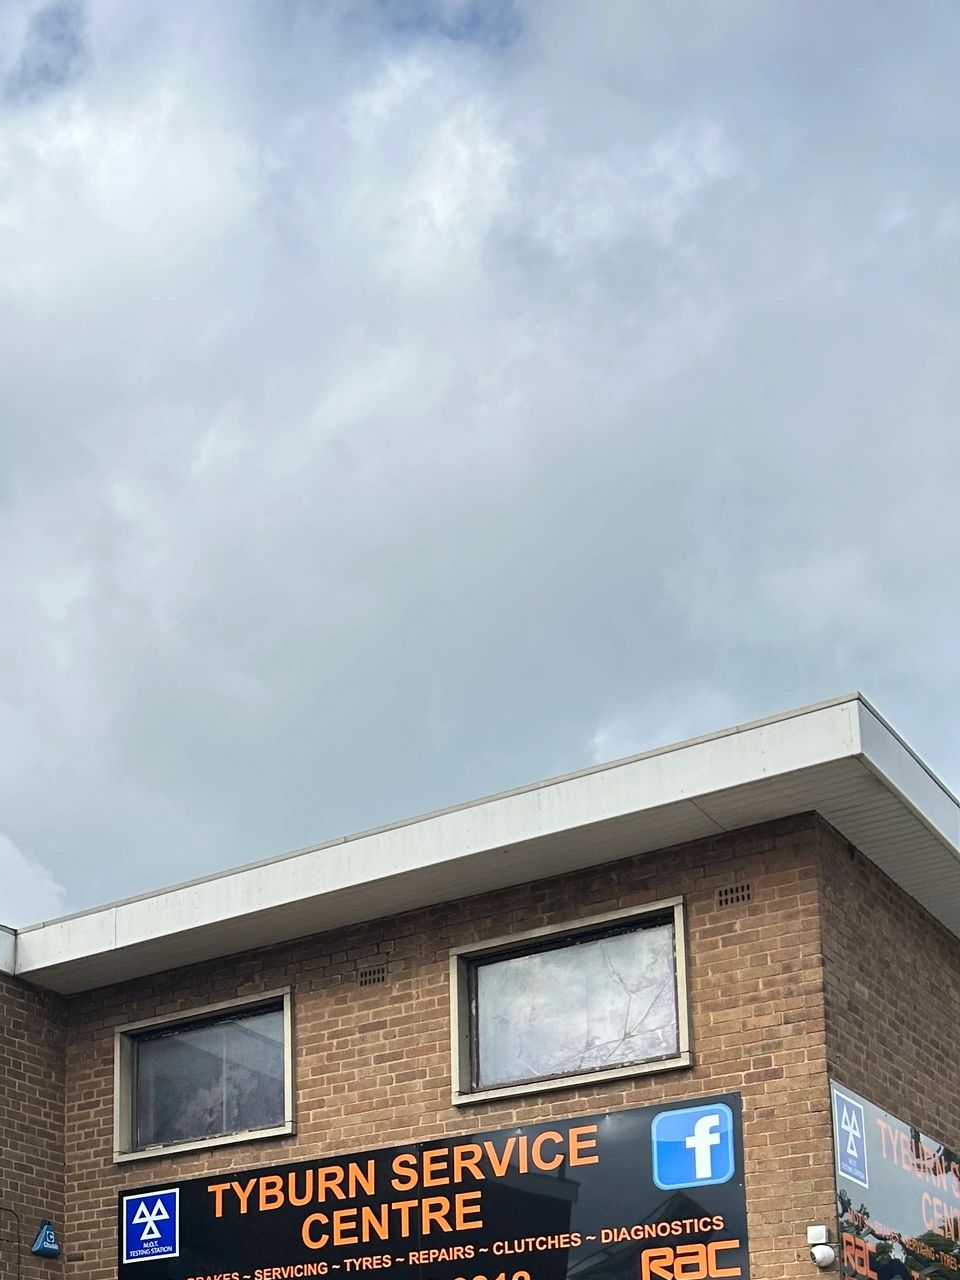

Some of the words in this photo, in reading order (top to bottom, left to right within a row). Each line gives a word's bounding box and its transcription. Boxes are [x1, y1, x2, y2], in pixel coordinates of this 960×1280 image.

[207, 1159, 376, 1218] TYBURN
[390, 1124, 600, 1192] SERVICE
[301, 1191, 484, 1250] CENTRE
[344, 1254, 392, 1272] TYRES
[408, 1245, 475, 1265] REPAIRS
[492, 1233, 581, 1256] CLUTCHES
[601, 1215, 725, 1244] DIAGNOSTICS
[129, 1248, 151, 1257] TESTING
[151, 1246, 173, 1255] STATION
